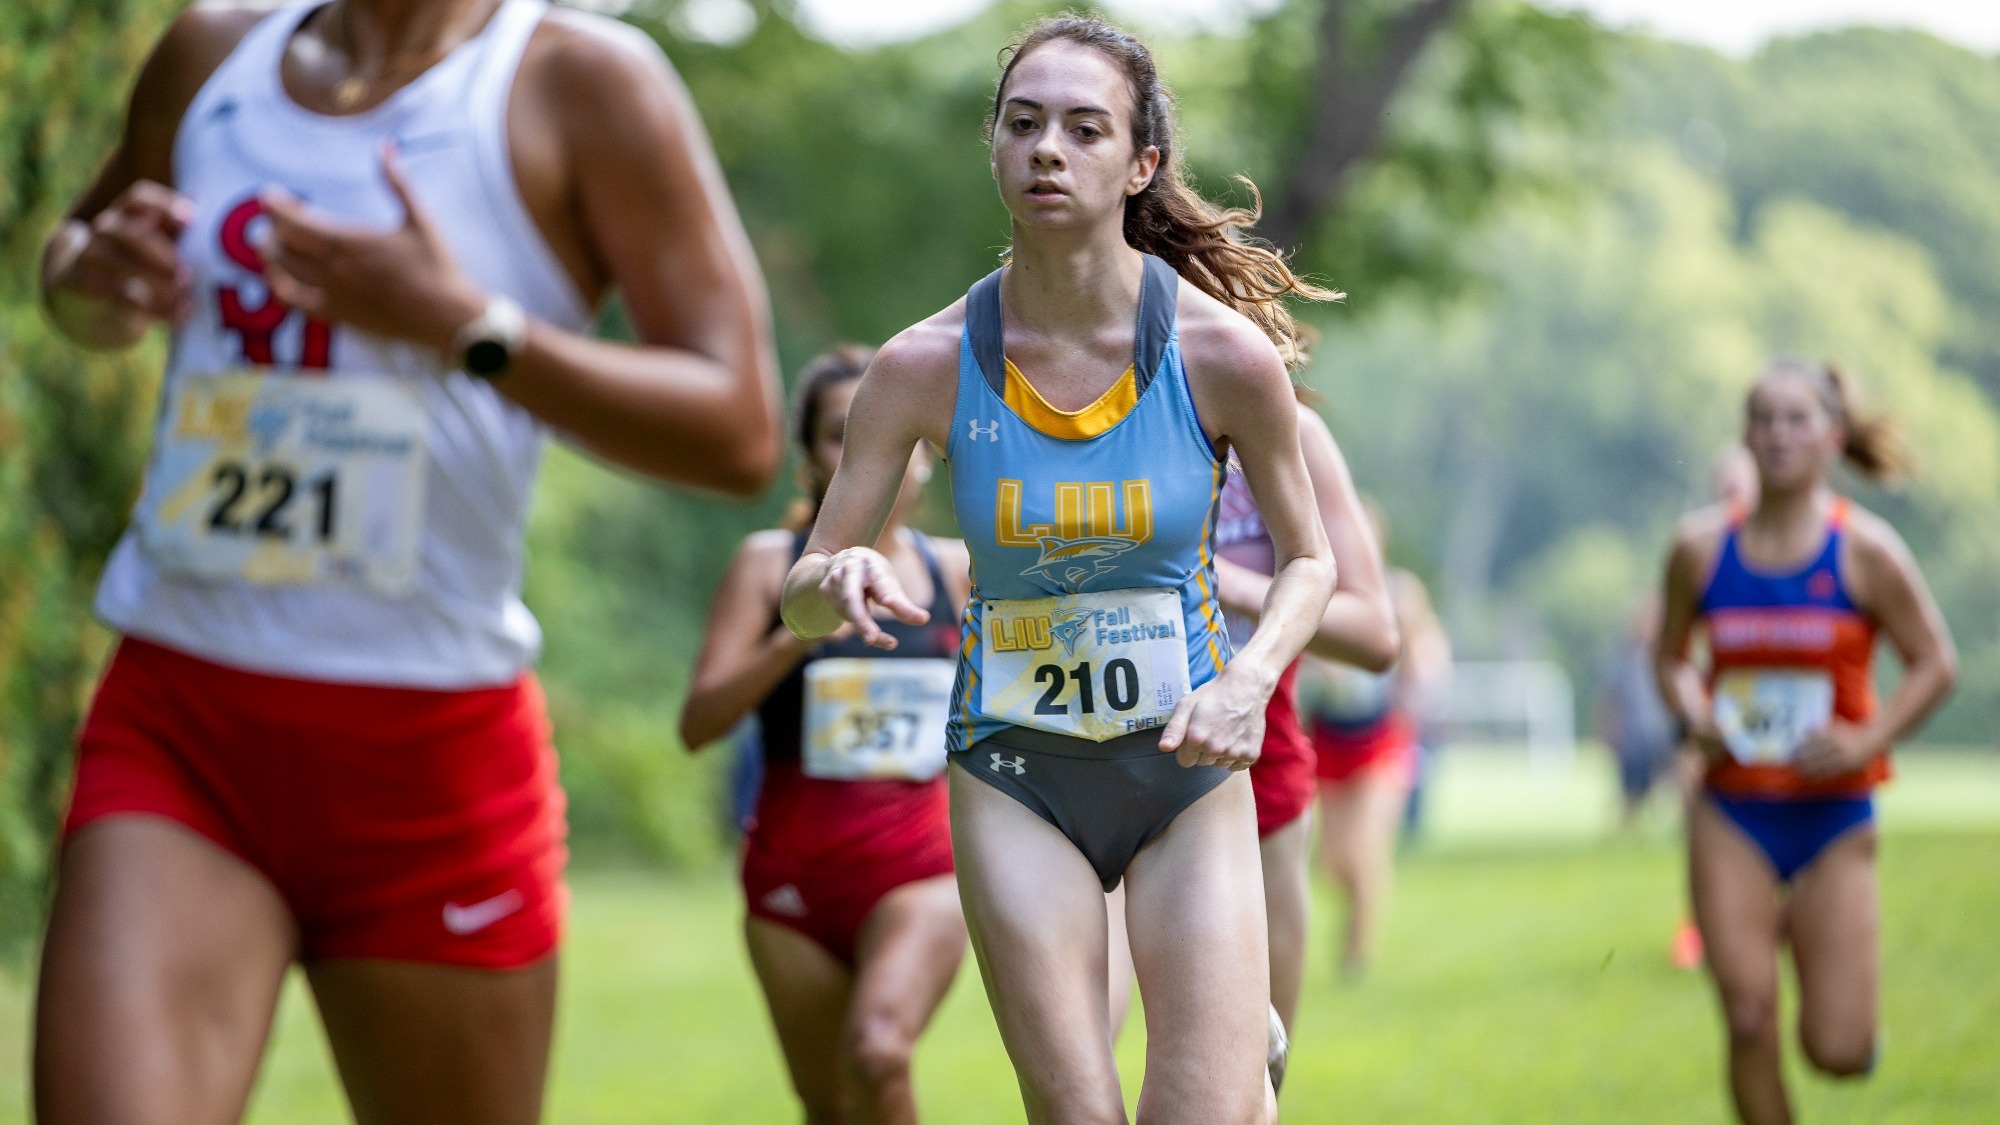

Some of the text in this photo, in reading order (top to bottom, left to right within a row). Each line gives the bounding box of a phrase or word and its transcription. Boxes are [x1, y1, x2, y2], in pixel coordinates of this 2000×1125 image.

[208, 463, 336, 541] 221
[995, 478, 1153, 547] LIU
[991, 615, 1052, 652] LIU
[1093, 606, 1130, 626] Fall
[1096, 620, 1176, 647] Festival
[1033, 657, 1140, 716] 210
